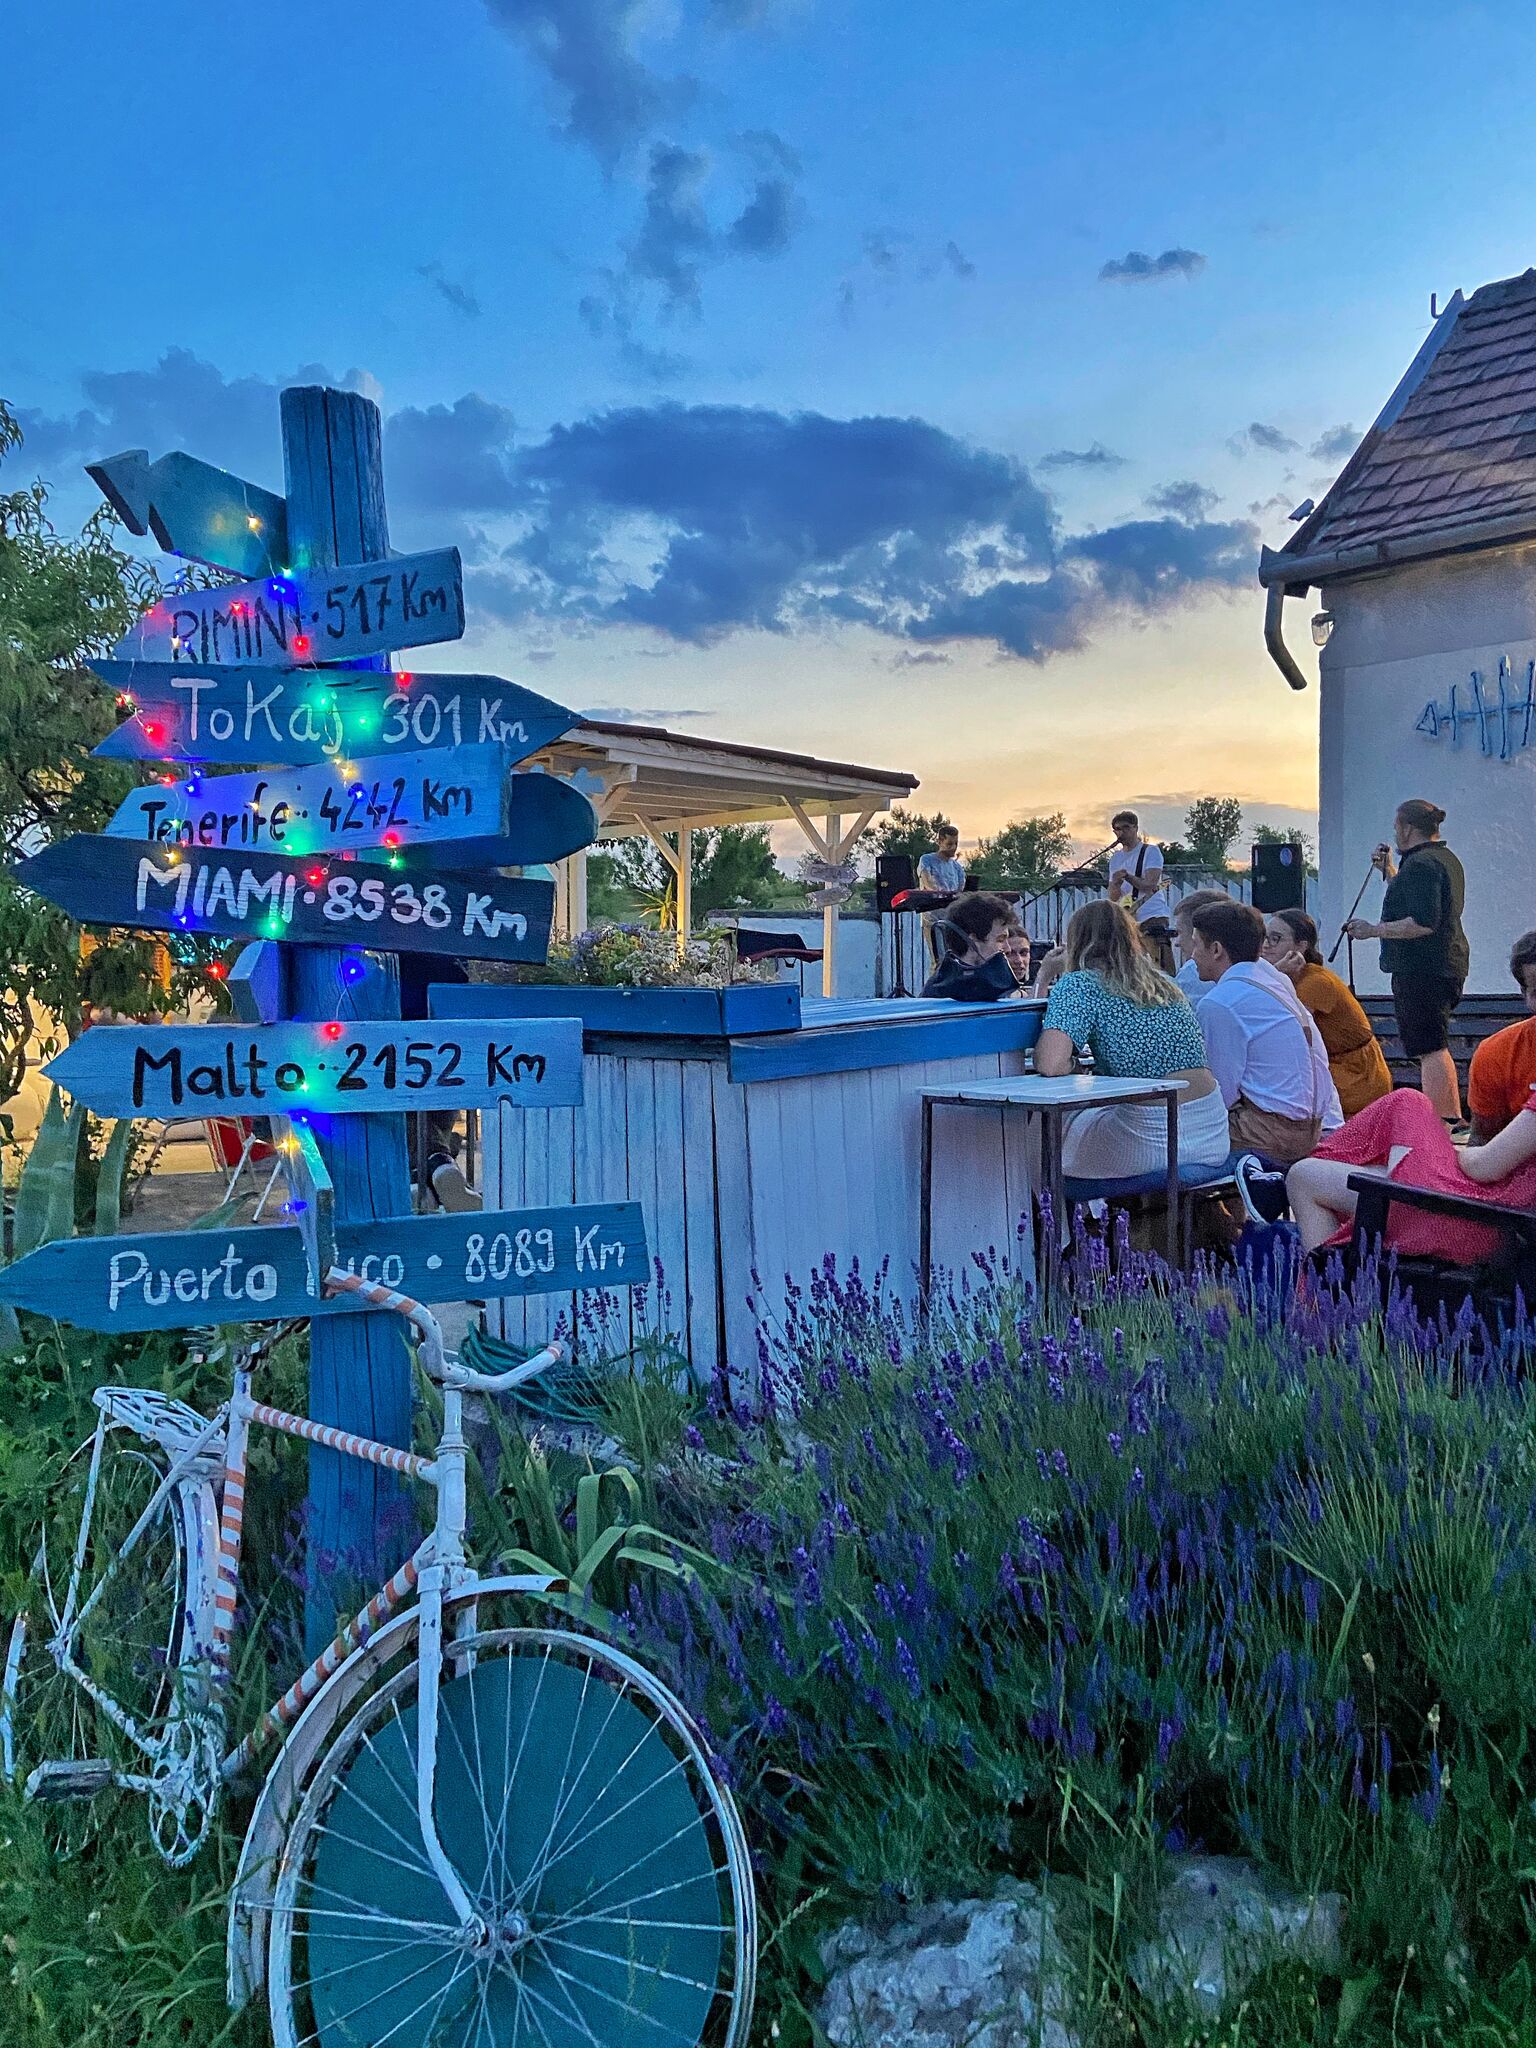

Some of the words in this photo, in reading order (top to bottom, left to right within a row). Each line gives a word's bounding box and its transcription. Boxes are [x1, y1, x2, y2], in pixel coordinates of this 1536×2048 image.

[326, 575, 393, 639] 517
[401, 571, 447, 622] Km
[382, 692, 461, 746] 301
[479, 697, 529, 744] Km
[139, 781, 290, 846] Tenerife
[319, 777, 409, 834] 4242
[422, 778, 473, 822] Km
[136, 857, 296, 924] MIAMI
[322, 875, 453, 929] 8538
[463, 892, 528, 941] Km
[336, 1042, 466, 1092] 2152
[487, 1041, 547, 1088] Km
[109, 1243, 278, 1312] Puerto
[465, 1228, 555, 1284] 8089
[574, 1224, 627, 1273] Km
